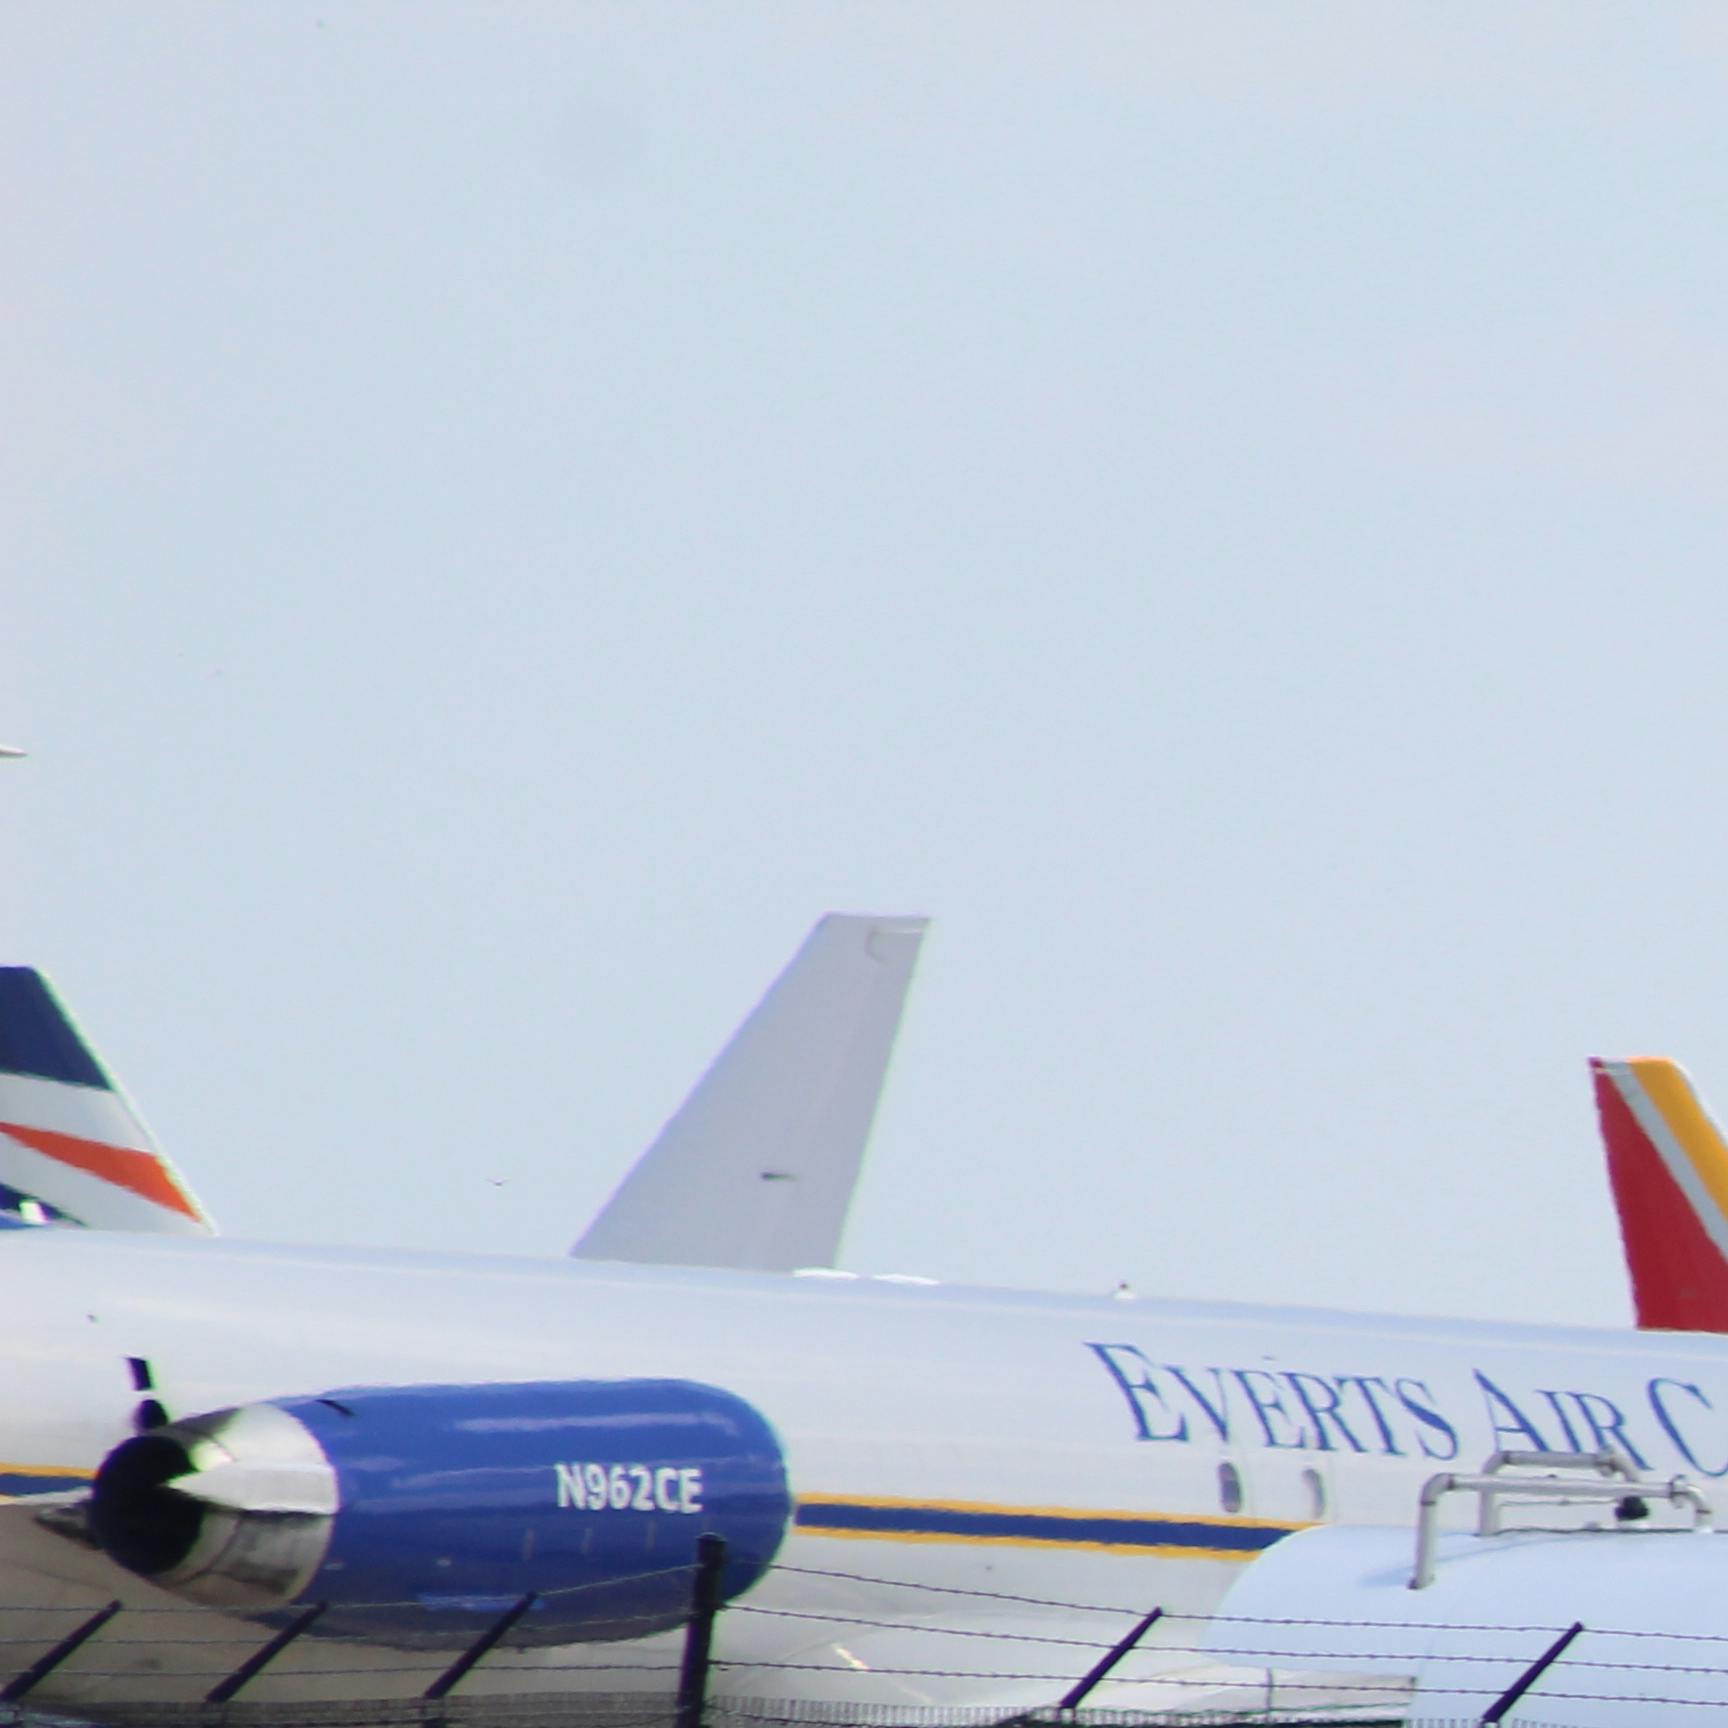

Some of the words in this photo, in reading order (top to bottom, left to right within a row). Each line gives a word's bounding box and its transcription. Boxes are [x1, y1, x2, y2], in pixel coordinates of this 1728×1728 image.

[1083, 1341, 1459, 1461] EVERTS
[1472, 1368, 1654, 1471] AIR
[554, 1462, 703, 1514] N962CE
